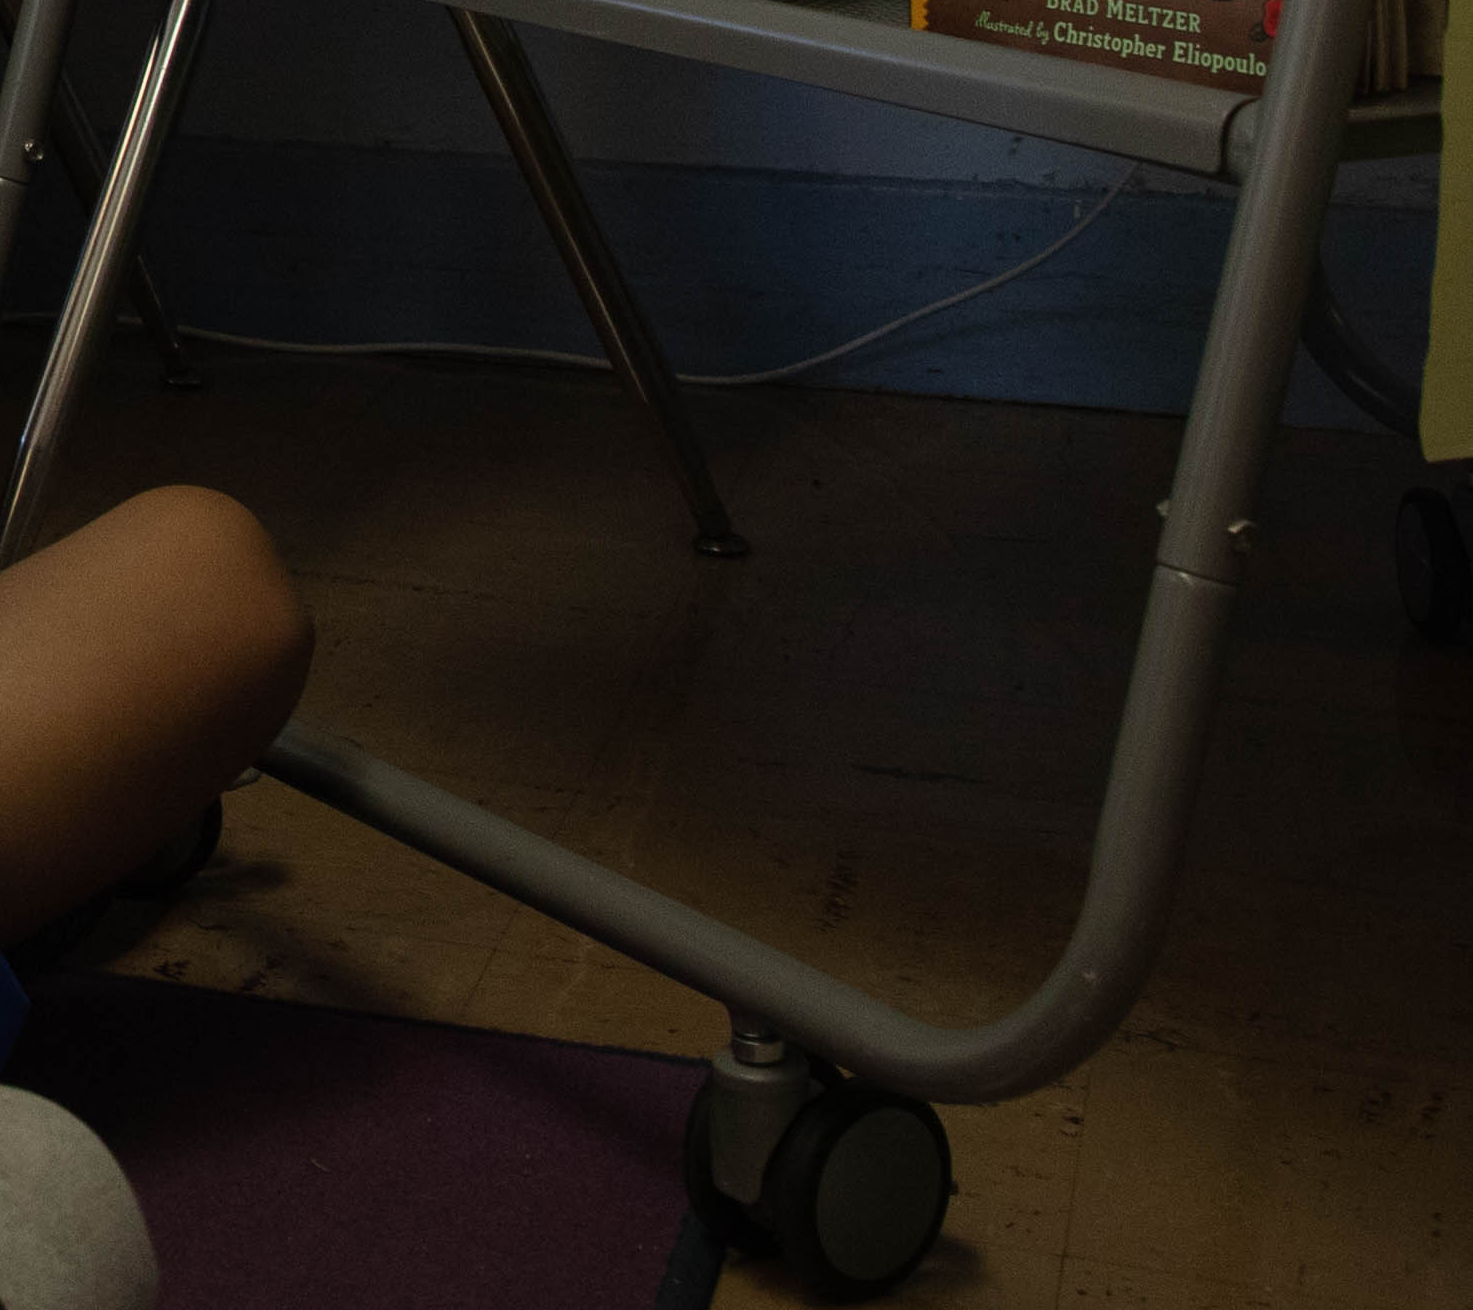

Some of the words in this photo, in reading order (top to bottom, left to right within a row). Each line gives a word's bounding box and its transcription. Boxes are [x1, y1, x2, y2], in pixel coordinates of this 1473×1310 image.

[1036, 17, 1050, 46] by
[1053, 20, 1167, 61] Christopher
[1172, 40, 1268, 78] Eliopoulo
